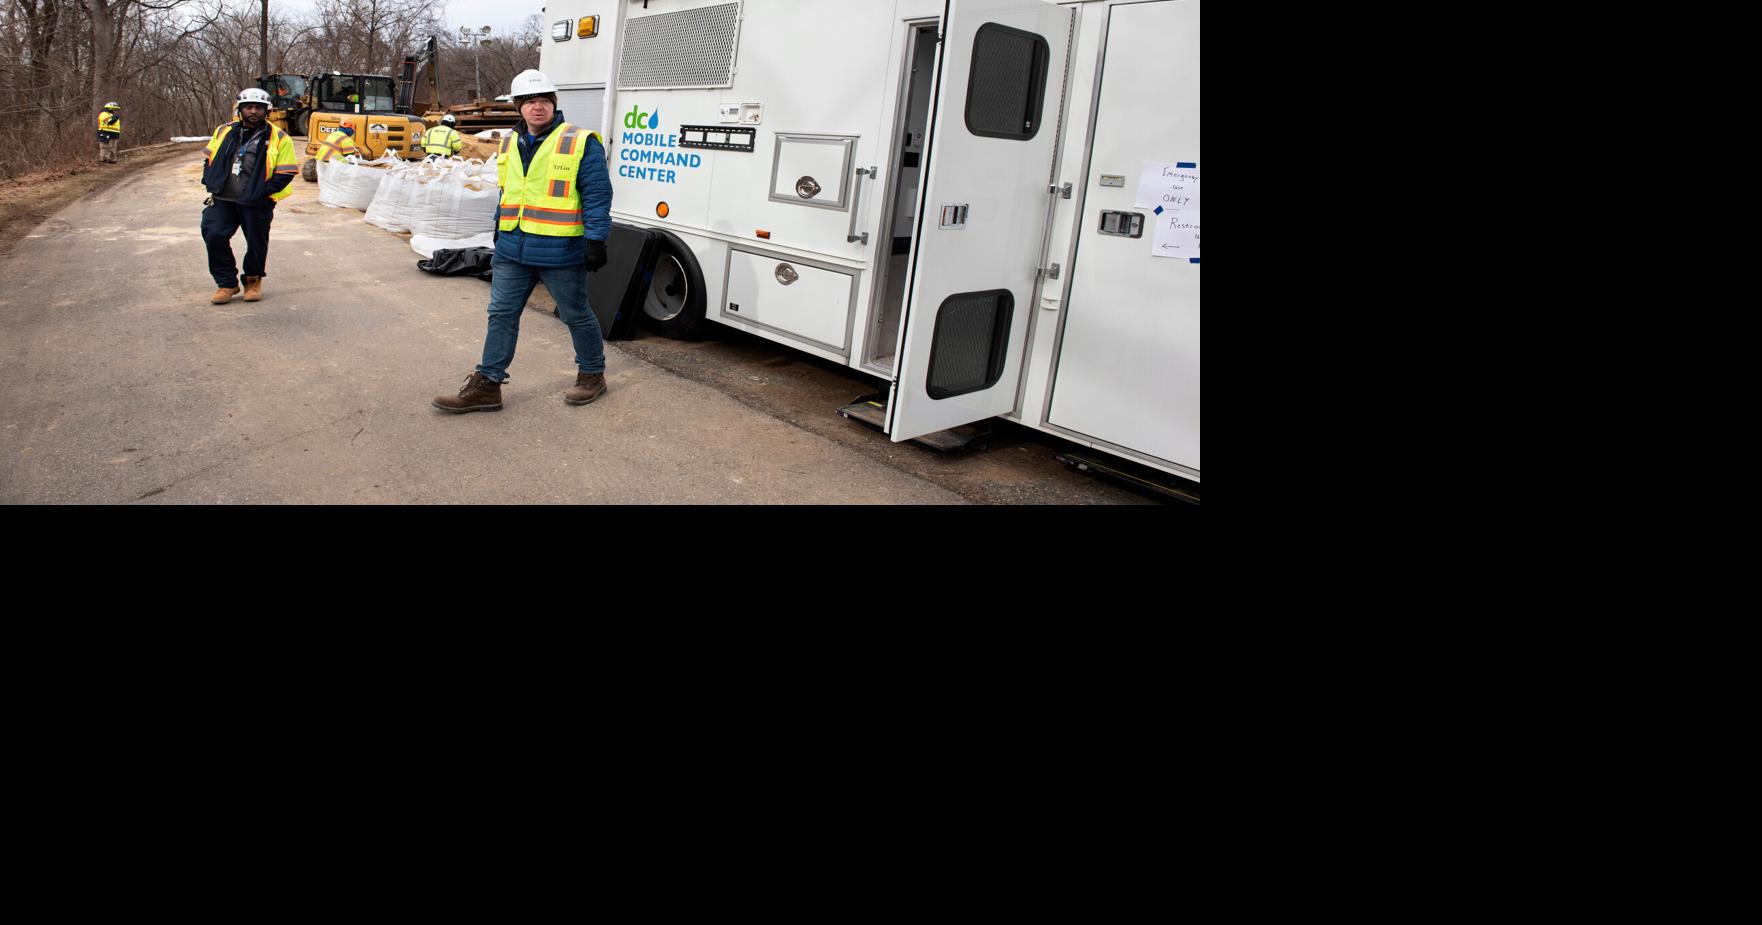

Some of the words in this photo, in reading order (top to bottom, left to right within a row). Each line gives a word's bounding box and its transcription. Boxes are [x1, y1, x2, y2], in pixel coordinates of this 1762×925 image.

[624, 105, 648, 129] dc
[622, 132, 677, 147] MOBILE
[621, 148, 701, 167] COMMAND
[619, 165, 676, 183] CENTER
[1162, 194, 1189, 205] ONLY
